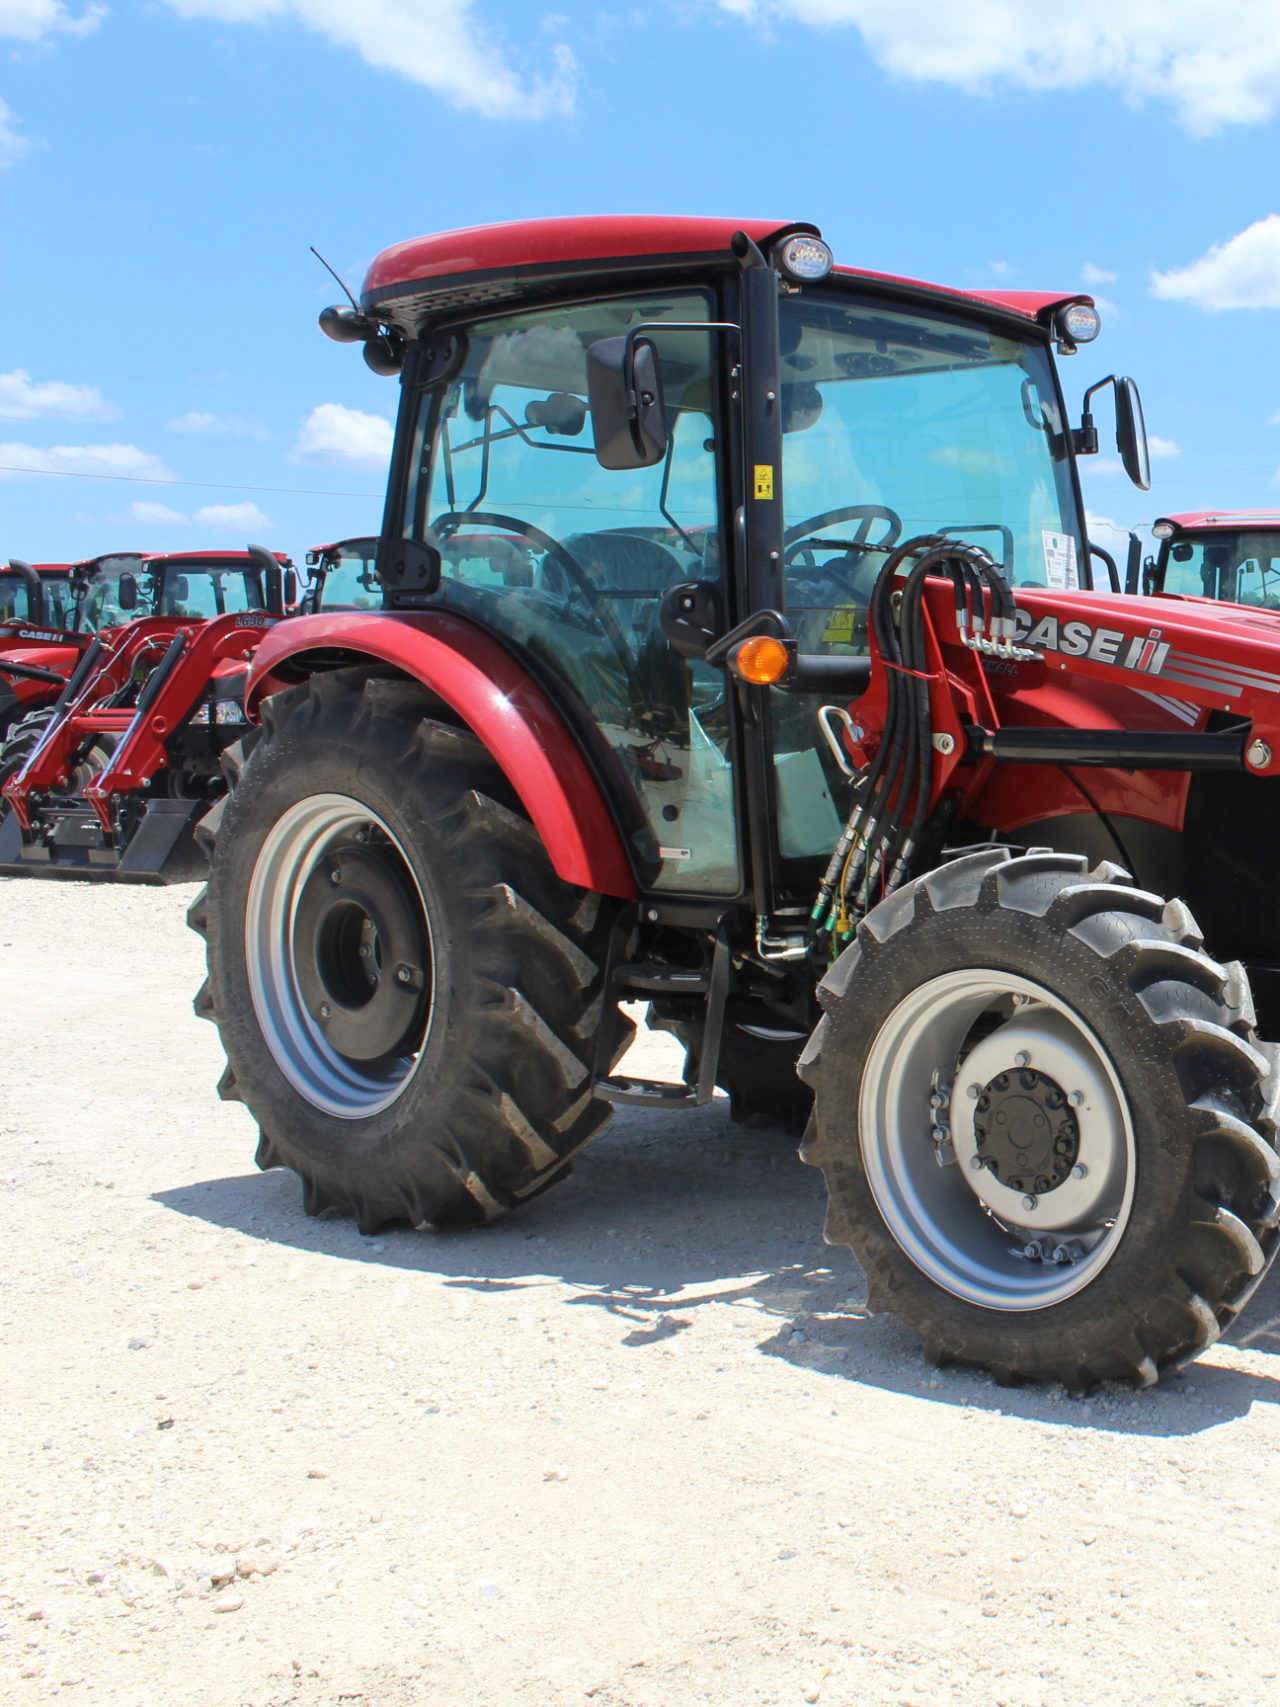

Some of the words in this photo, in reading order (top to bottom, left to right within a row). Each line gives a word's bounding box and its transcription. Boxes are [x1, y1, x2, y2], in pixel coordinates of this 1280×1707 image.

[235, 615, 265, 628] L630
[19, 630, 51, 640] CASE
[1013, 608, 1124, 665] CASE
